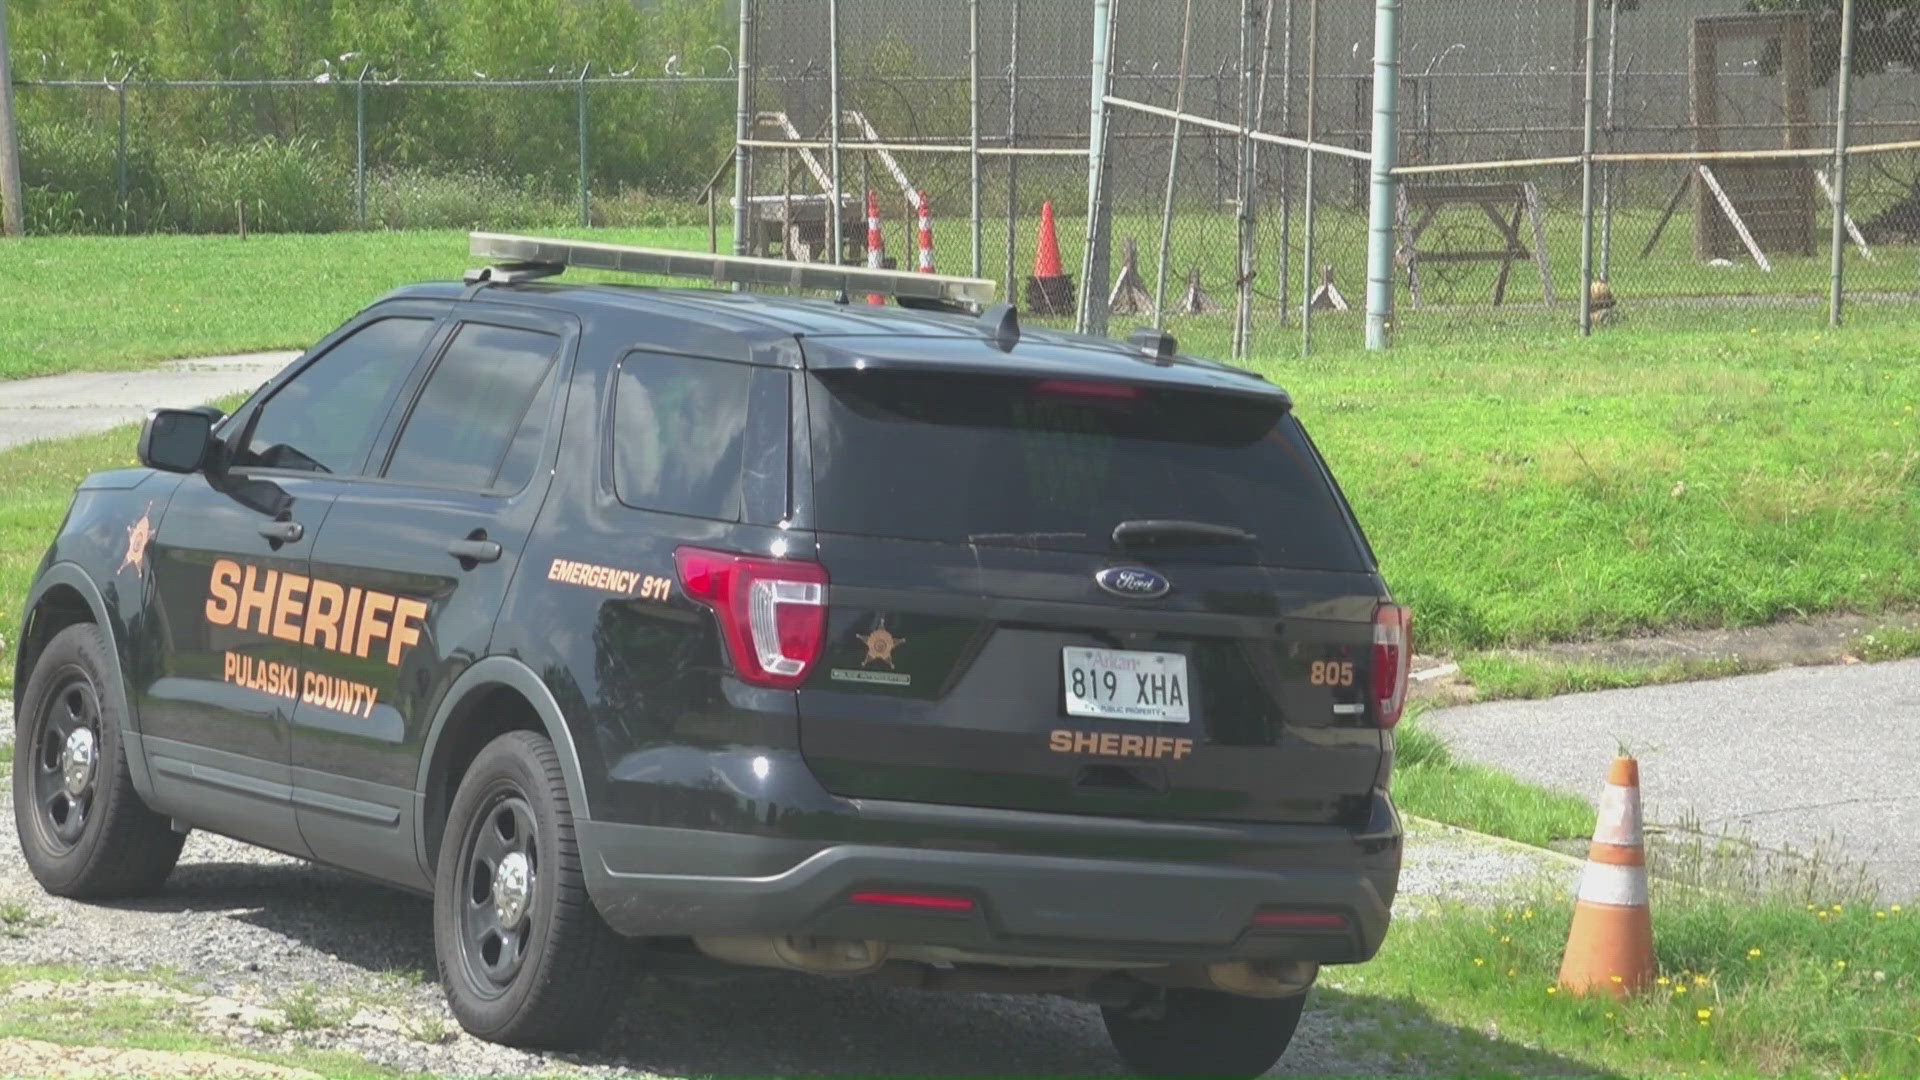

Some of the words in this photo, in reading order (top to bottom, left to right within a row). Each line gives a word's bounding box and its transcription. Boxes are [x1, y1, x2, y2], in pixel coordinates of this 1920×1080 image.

[548, 558, 640, 594] EMERGENCY
[641, 576, 671, 601] 911
[1116, 571, 1154, 590] Ford
[206, 560, 427, 666] SHERIFF
[225, 652, 297, 700] PULASKI
[303, 669, 379, 719] COUNTY
[1072, 668, 1117, 701] 819
[1136, 673, 1183, 706] XHA
[1311, 661, 1353, 686] 805
[1050, 729, 1192, 760] SHERIFF
